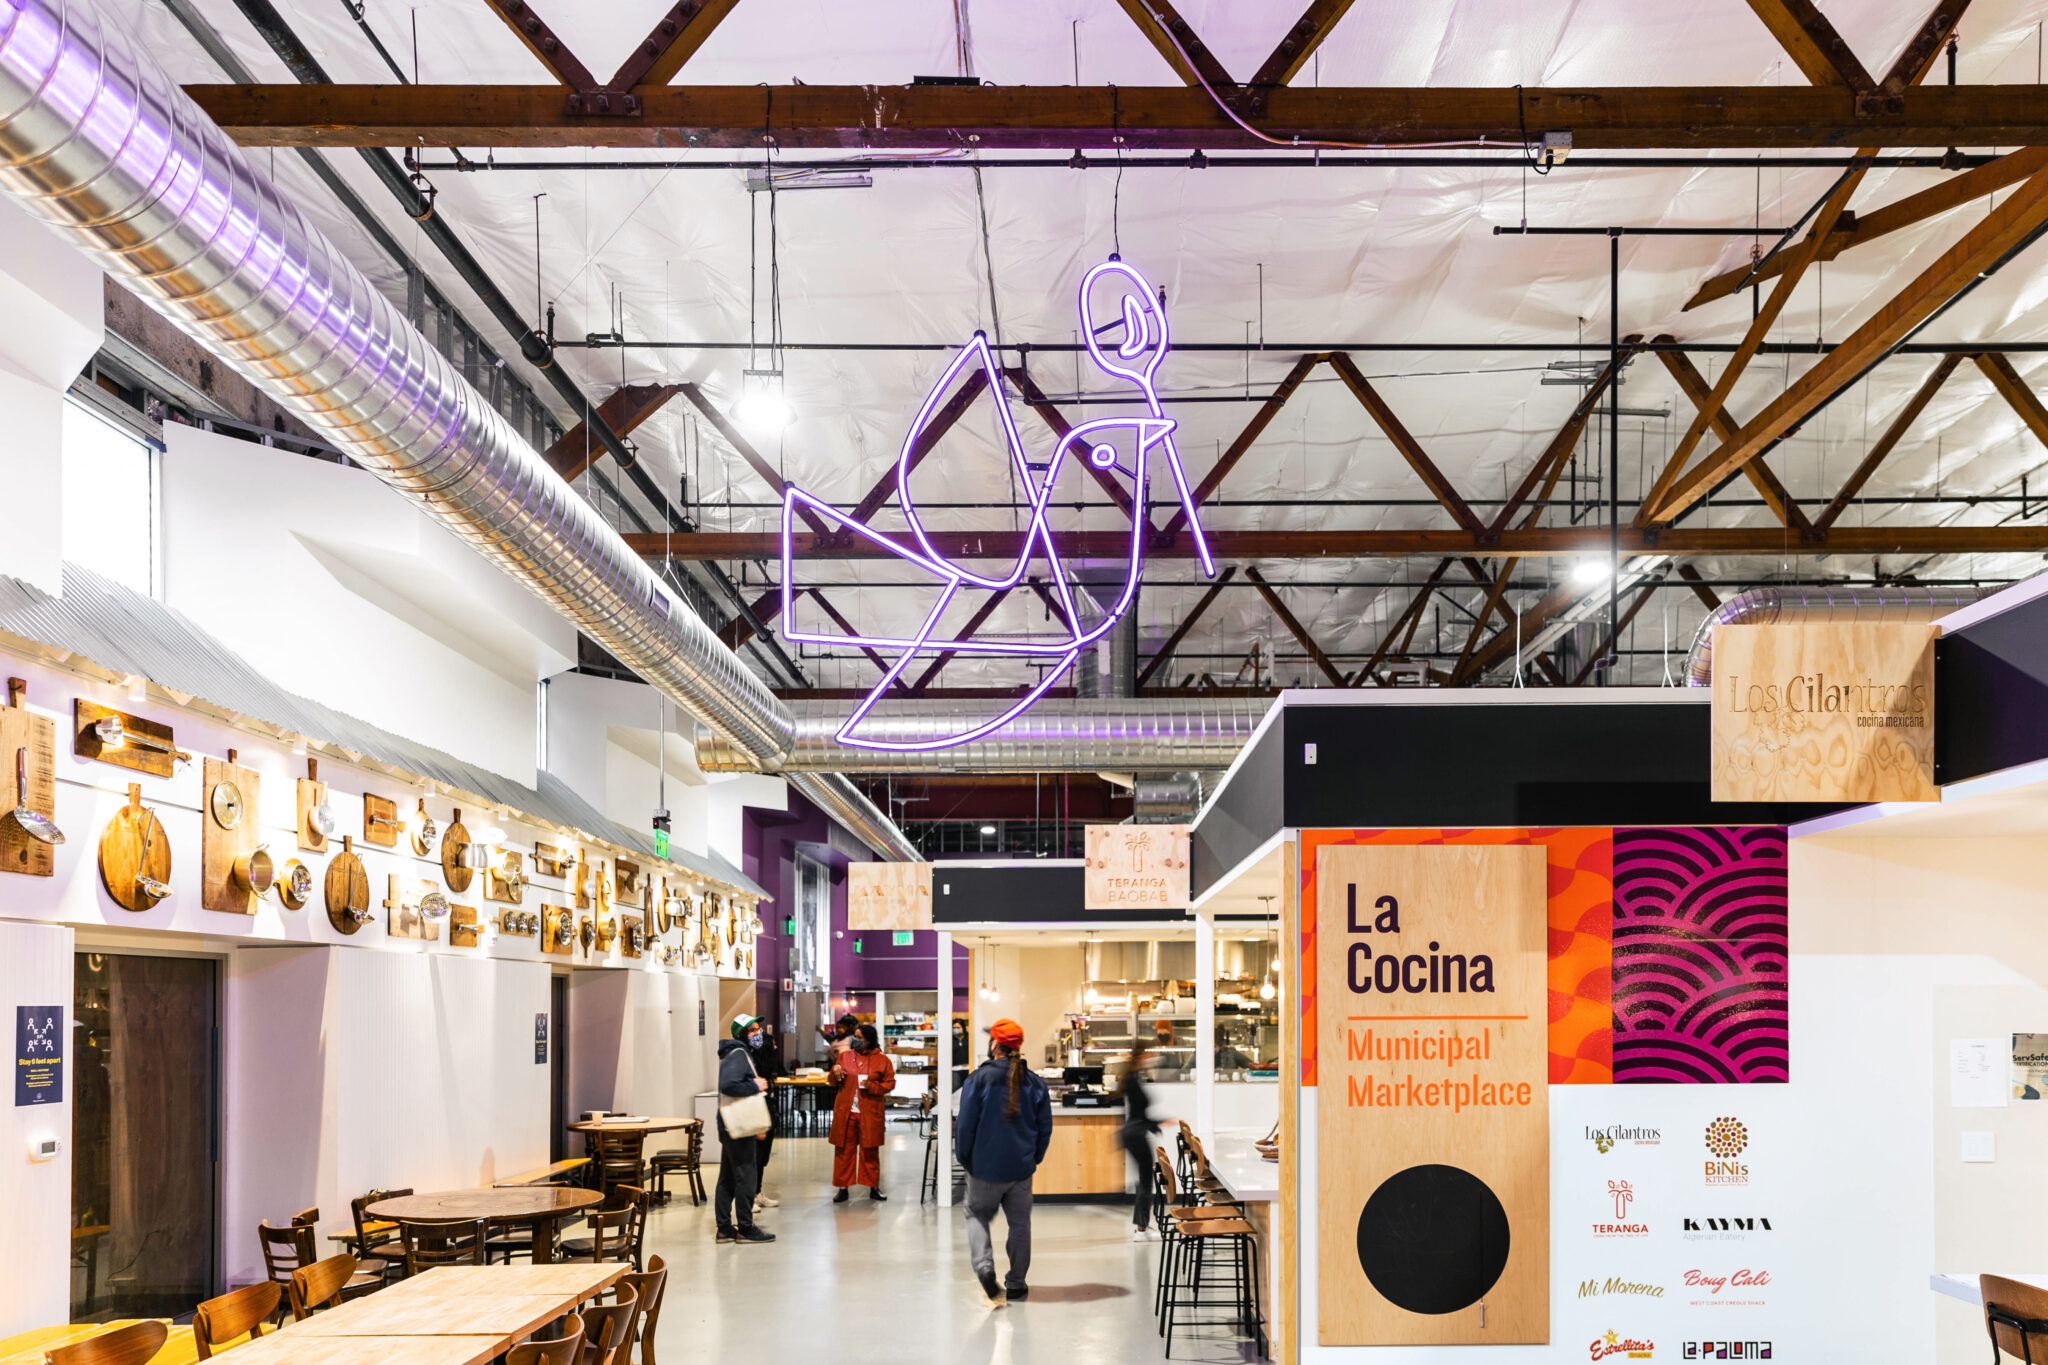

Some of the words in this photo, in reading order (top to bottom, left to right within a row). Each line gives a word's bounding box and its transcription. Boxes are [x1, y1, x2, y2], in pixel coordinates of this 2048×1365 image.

[1729, 675, 1777, 713] Los
[1785, 673, 1927, 713] Cilantros
[1857, 714, 1884, 728] cocina
[1885, 714, 1925, 728] mexicana
[1107, 878, 1167, 888] TERANGA
[1108, 890, 1169, 903] BAOBAB
[1347, 883, 1400, 933] La
[1347, 941, 1495, 993] Cocina
[1347, 1027, 1490, 1067] Municipal
[18, 1058, 31, 1066] Stay
[1347, 1073, 1532, 1114] Marketplace
[1585, 1125, 1605, 1140] Los
[1606, 1124, 1661, 1140] Cilantros
[1705, 1175, 1749, 1183] KITCHEN
[1592, 1224, 1649, 1233] TERANGA
[1683, 1218, 1772, 1231] KAYMA
[1731, 1269, 1772, 1286] Cali
[1578, 1279, 1599, 1299] Mi
[1602, 1277, 1664, 1298] Morena
[1590, 1339, 1655, 1361] Estrellita's
